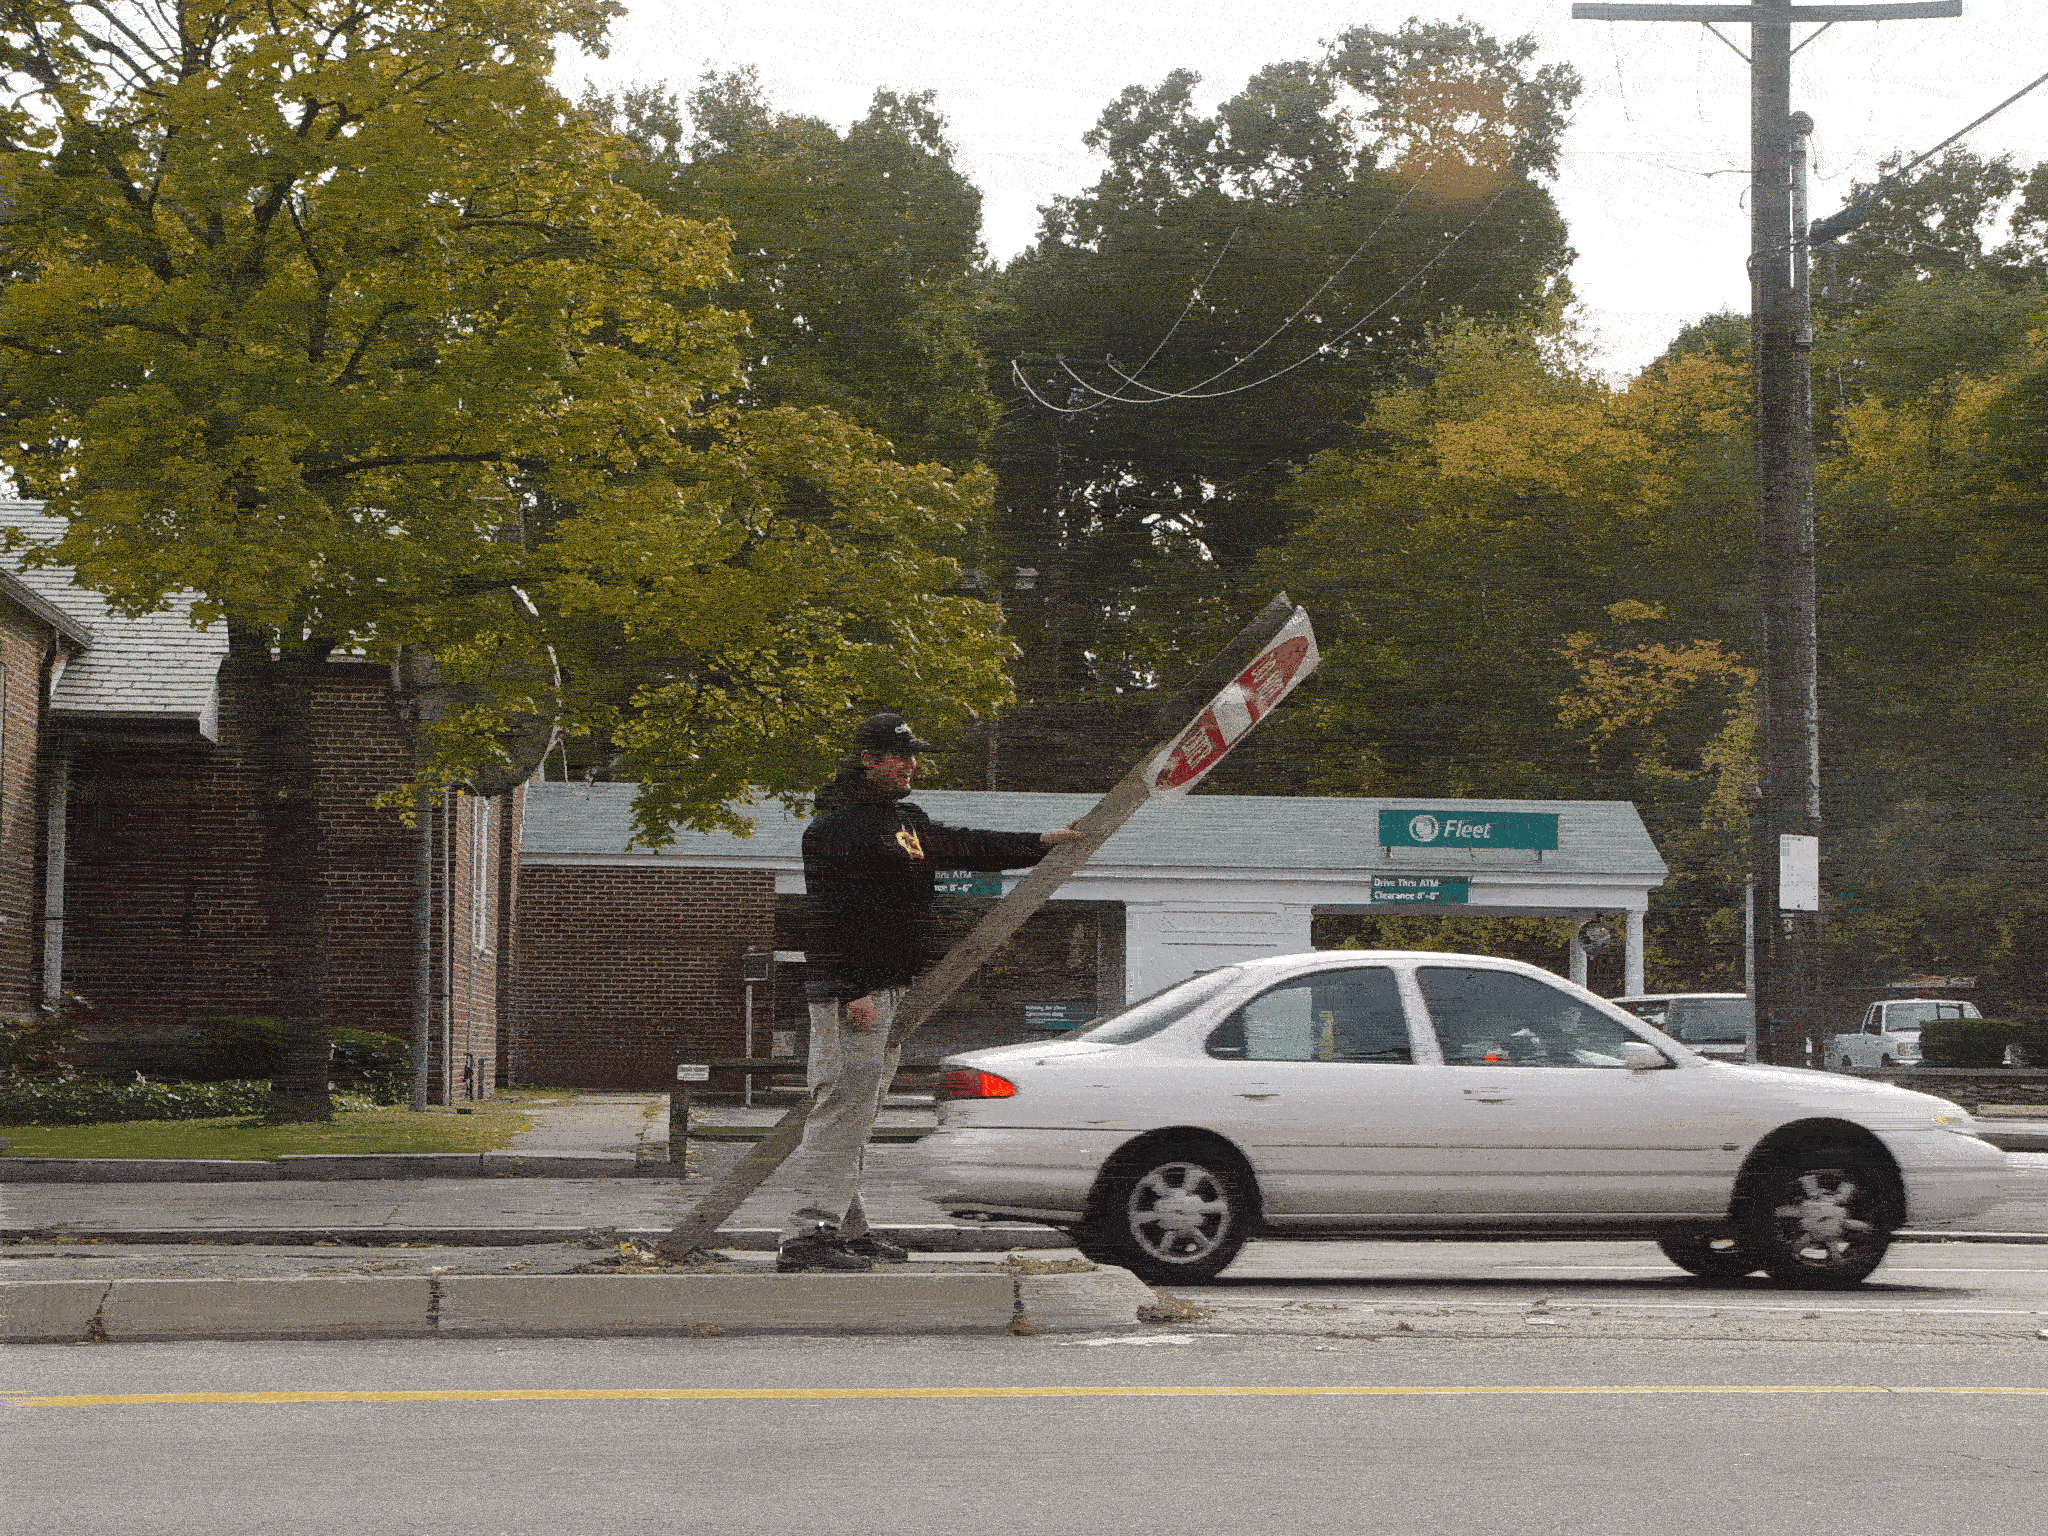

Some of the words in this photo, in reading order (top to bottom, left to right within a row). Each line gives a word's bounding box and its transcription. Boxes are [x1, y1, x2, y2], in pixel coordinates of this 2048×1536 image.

[1250, 650, 1276, 685] DO
[1181, 725, 1213, 770] ENTER
[1444, 819, 1492, 839] Fleet
[1374, 878, 1396, 887] Drive
[1398, 878, 1417, 887] Thru
[1419, 879, 1439, 887] ATM
[1374, 890, 1415, 900] Clearance
